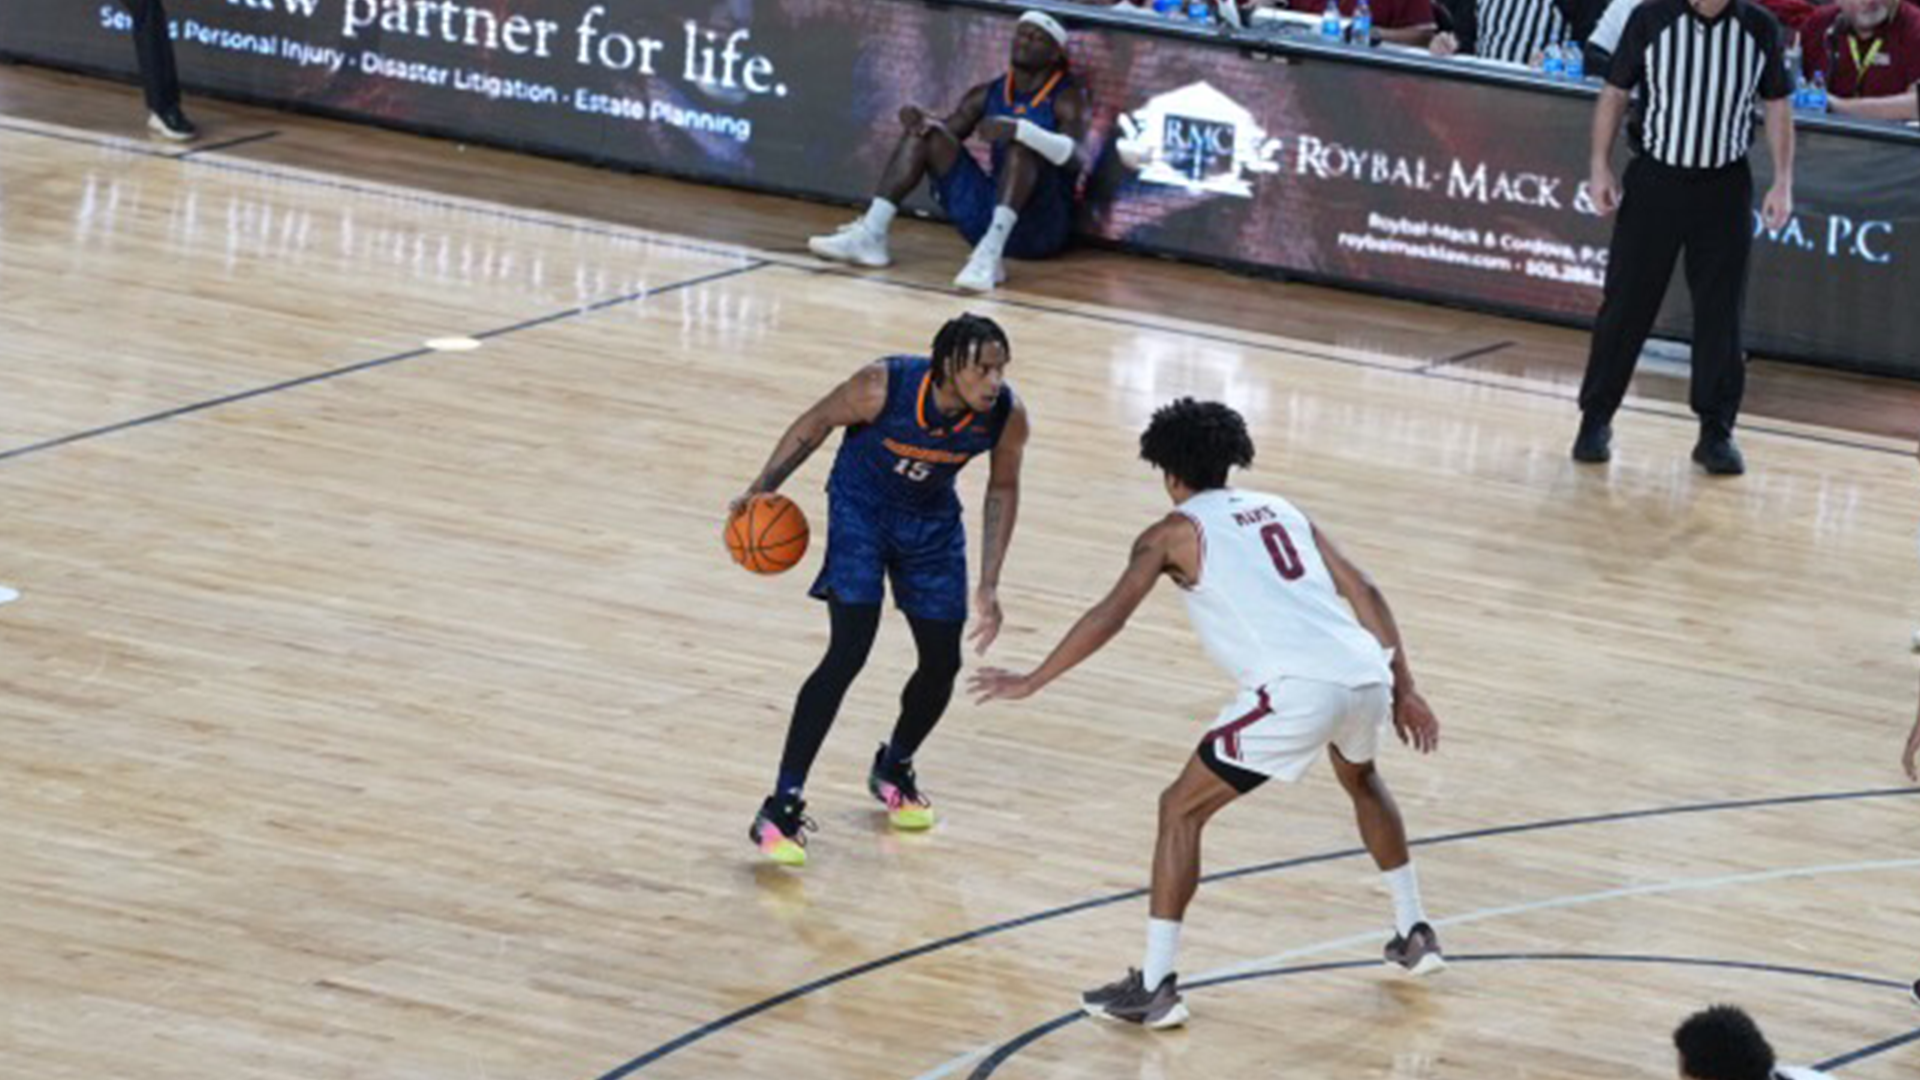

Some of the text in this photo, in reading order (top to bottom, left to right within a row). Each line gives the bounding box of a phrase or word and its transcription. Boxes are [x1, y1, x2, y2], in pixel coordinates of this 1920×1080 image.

[340, 0, 788, 97] partner for life.
[184, 20, 276, 55] Personal
[282, 39, 345, 71] Injury
[361, 52, 448, 86] Disaster
[454, 69, 558, 103] Litigation
[574, 88, 645, 121] Estate
[649, 100, 751, 141] Planning
[1165, 117, 1236, 156] RMC
[893, 457, 931, 482] 15
[1260, 521, 1305, 581] 0
